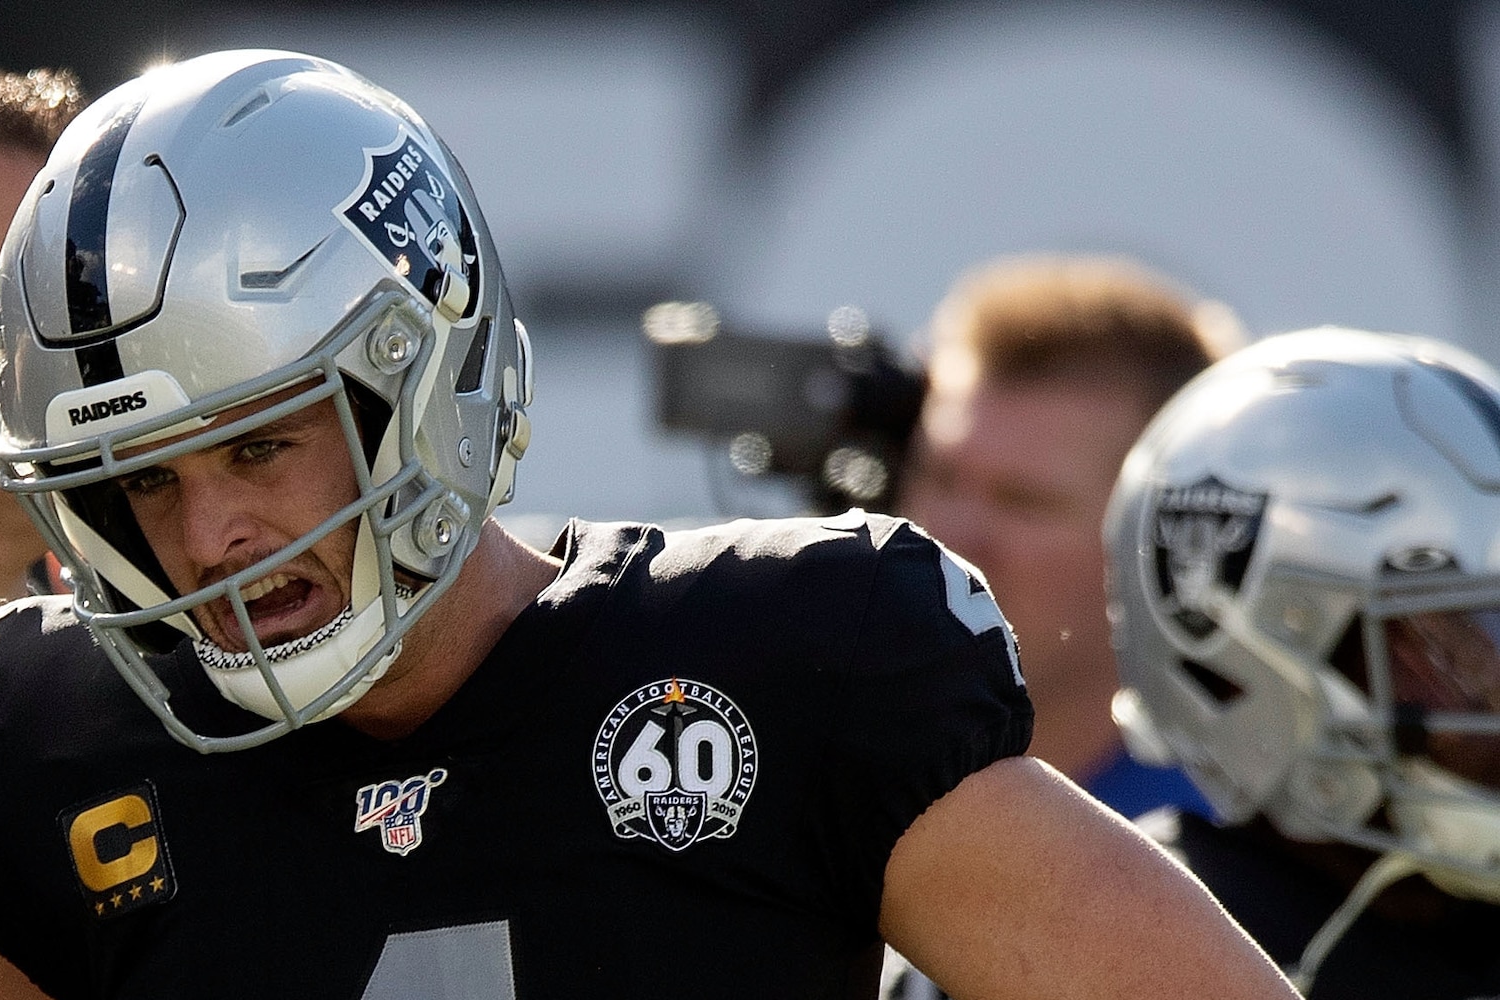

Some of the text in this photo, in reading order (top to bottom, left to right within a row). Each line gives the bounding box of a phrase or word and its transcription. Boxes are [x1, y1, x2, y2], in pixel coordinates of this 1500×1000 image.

[358, 144, 423, 222] RAIDERS
[68, 391, 147, 426] RAIDERS
[596, 683, 754, 801] AMERICAN FOOTBALL LEAGUE
[617, 719, 732, 799] 60
[359, 779, 427, 819] 100
[613, 802, 641, 819] 1960
[652, 796, 699, 805] RAIDERS
[711, 802, 737, 818] 2019
[69, 794, 158, 892] C
[388, 827, 415, 845] NFL
